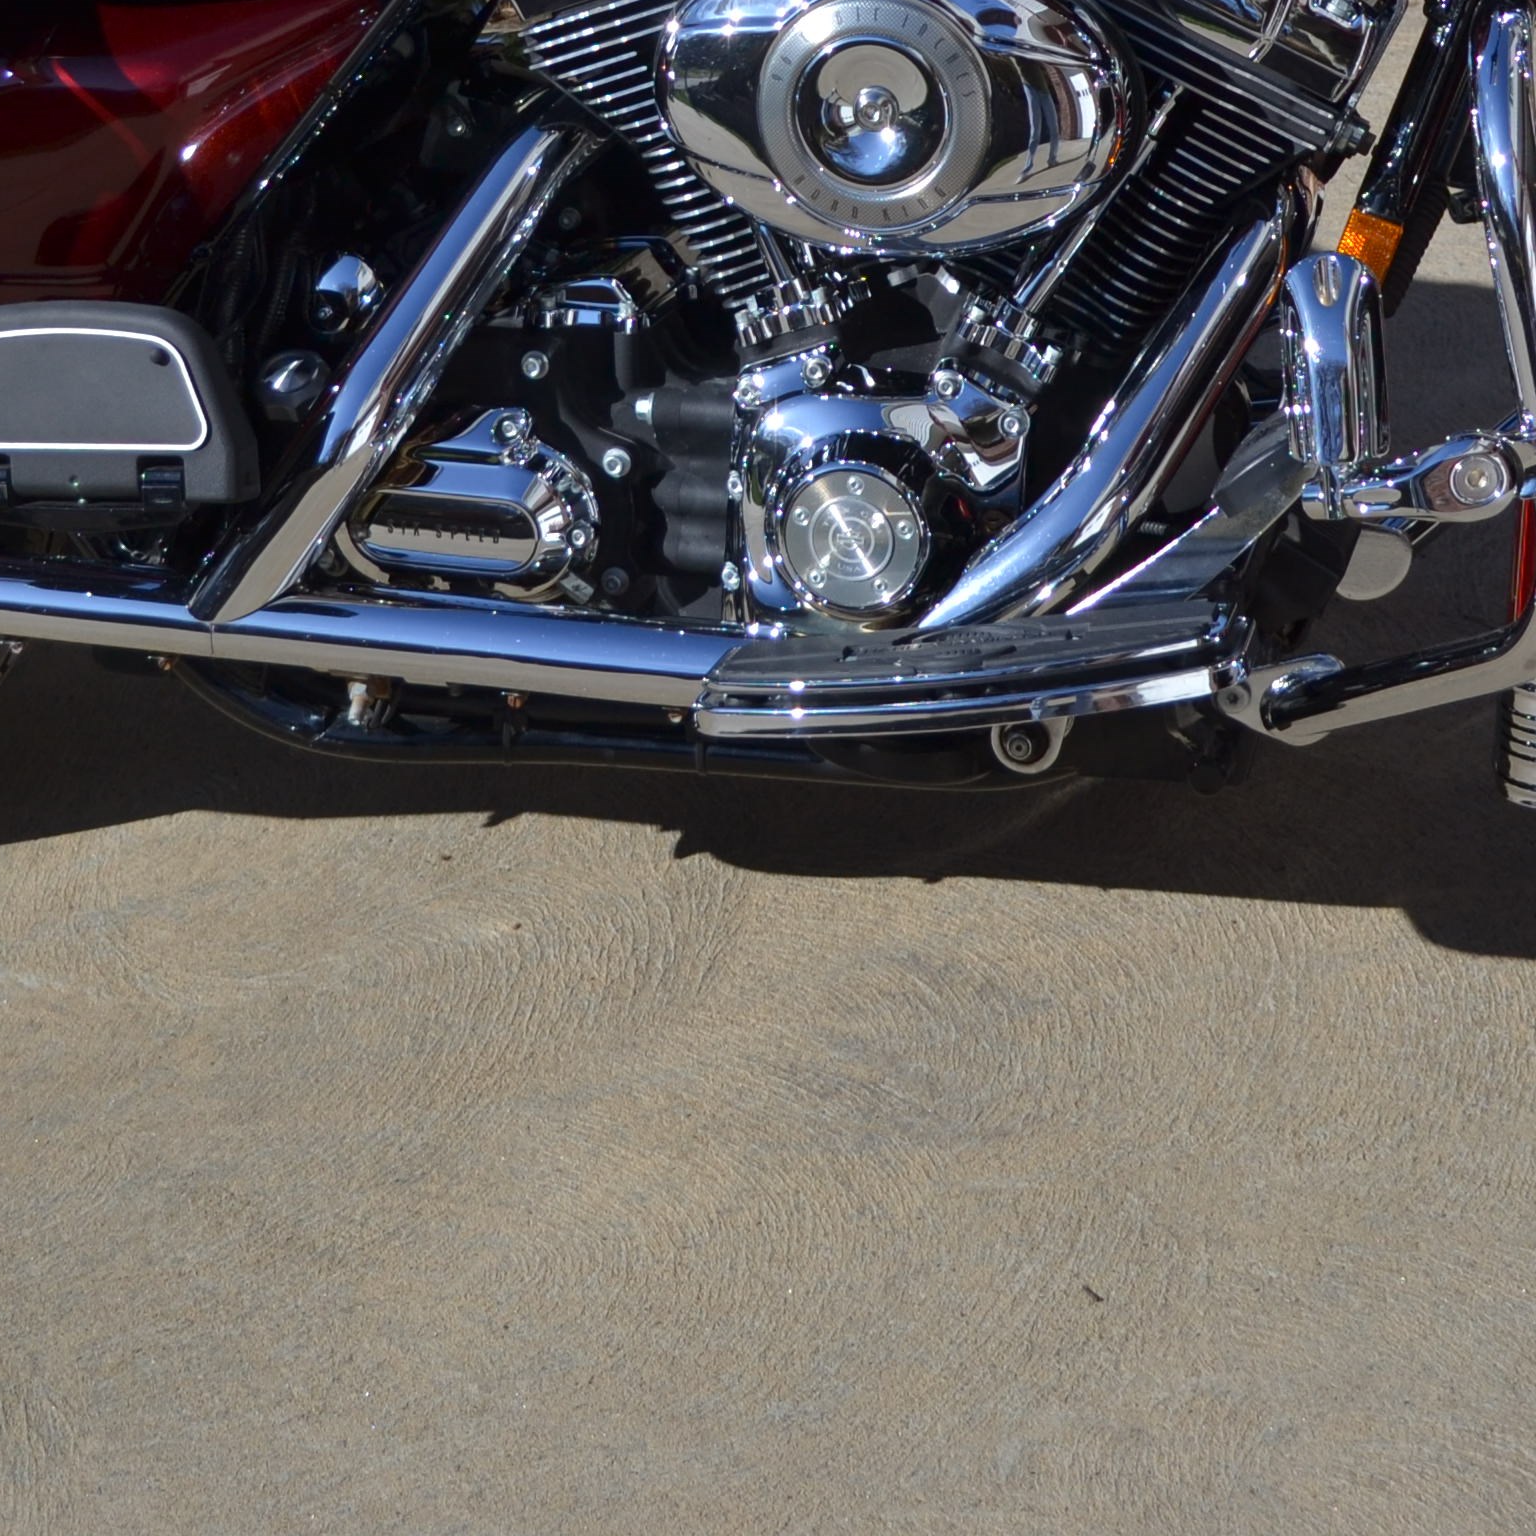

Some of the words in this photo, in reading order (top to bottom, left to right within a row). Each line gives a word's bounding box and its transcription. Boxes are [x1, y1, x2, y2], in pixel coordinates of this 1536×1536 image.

[900, 13, 978, 99] INCHES
[793, 174, 860, 220] ROAD
[881, 185, 949, 222] KING
[387, 518, 420, 536] SIX
[435, 523, 501, 544] SPEED
